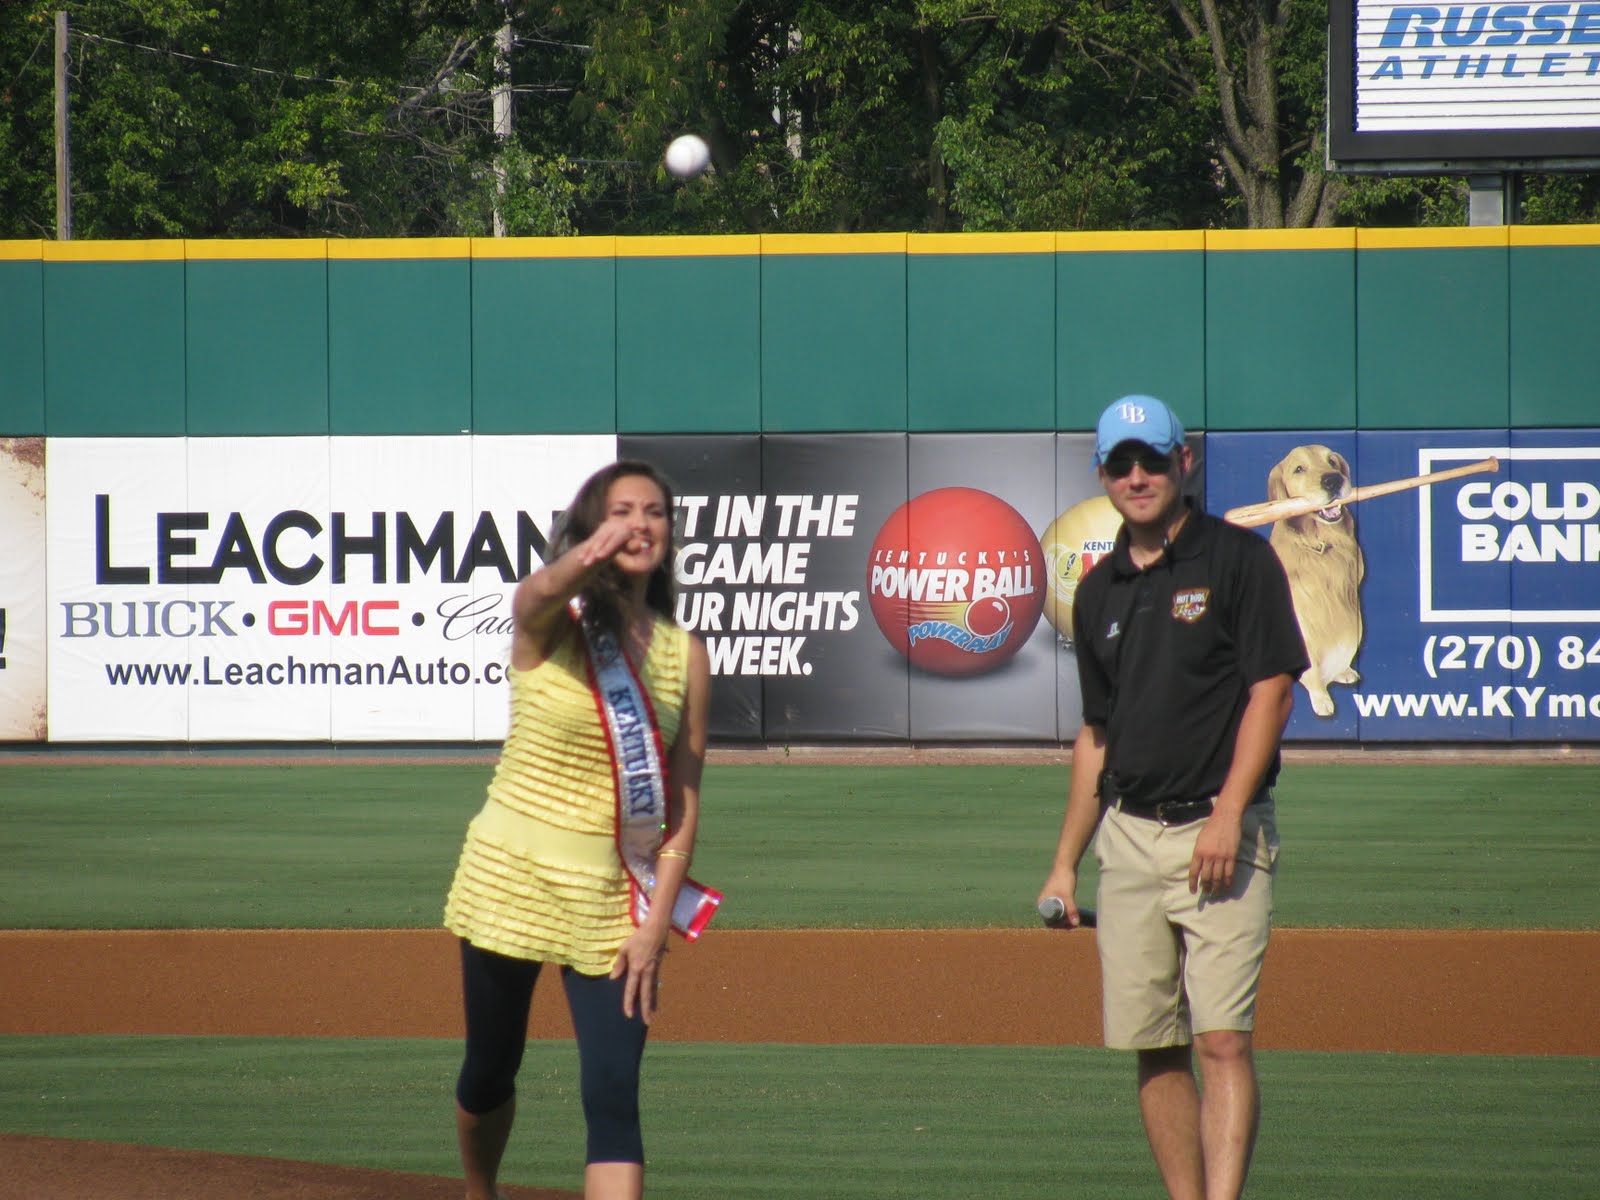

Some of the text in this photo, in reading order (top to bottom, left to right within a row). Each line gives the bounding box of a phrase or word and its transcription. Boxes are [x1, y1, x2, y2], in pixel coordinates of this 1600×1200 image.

[1378, 4, 1600, 48] RUSSE
[1369, 52, 1600, 80] ATHLET
[1116, 402, 1146, 424] TB
[673, 494, 859, 538] T IN THE
[1456, 482, 1600, 520] COLD
[95, 494, 570, 585] LEACHMAN
[875, 550, 1030, 565] KENTUCKY'S
[1083, 541, 1117, 551] KENT
[673, 542, 811, 585] GAME
[871, 565, 1034, 602] POWER BALL
[60, 600, 238, 637] BUICK
[267, 600, 400, 636] GMC
[673, 591, 860, 632] UR NIGHTS
[706, 636, 813, 676] WEEK.
[908, 620, 1014, 654] POWER PLAY
[105, 656, 511, 686] www.LeachmanAuto.c
[1423, 635, 1541, 678] (270)
[608, 686, 655, 815] KENTUCKY
